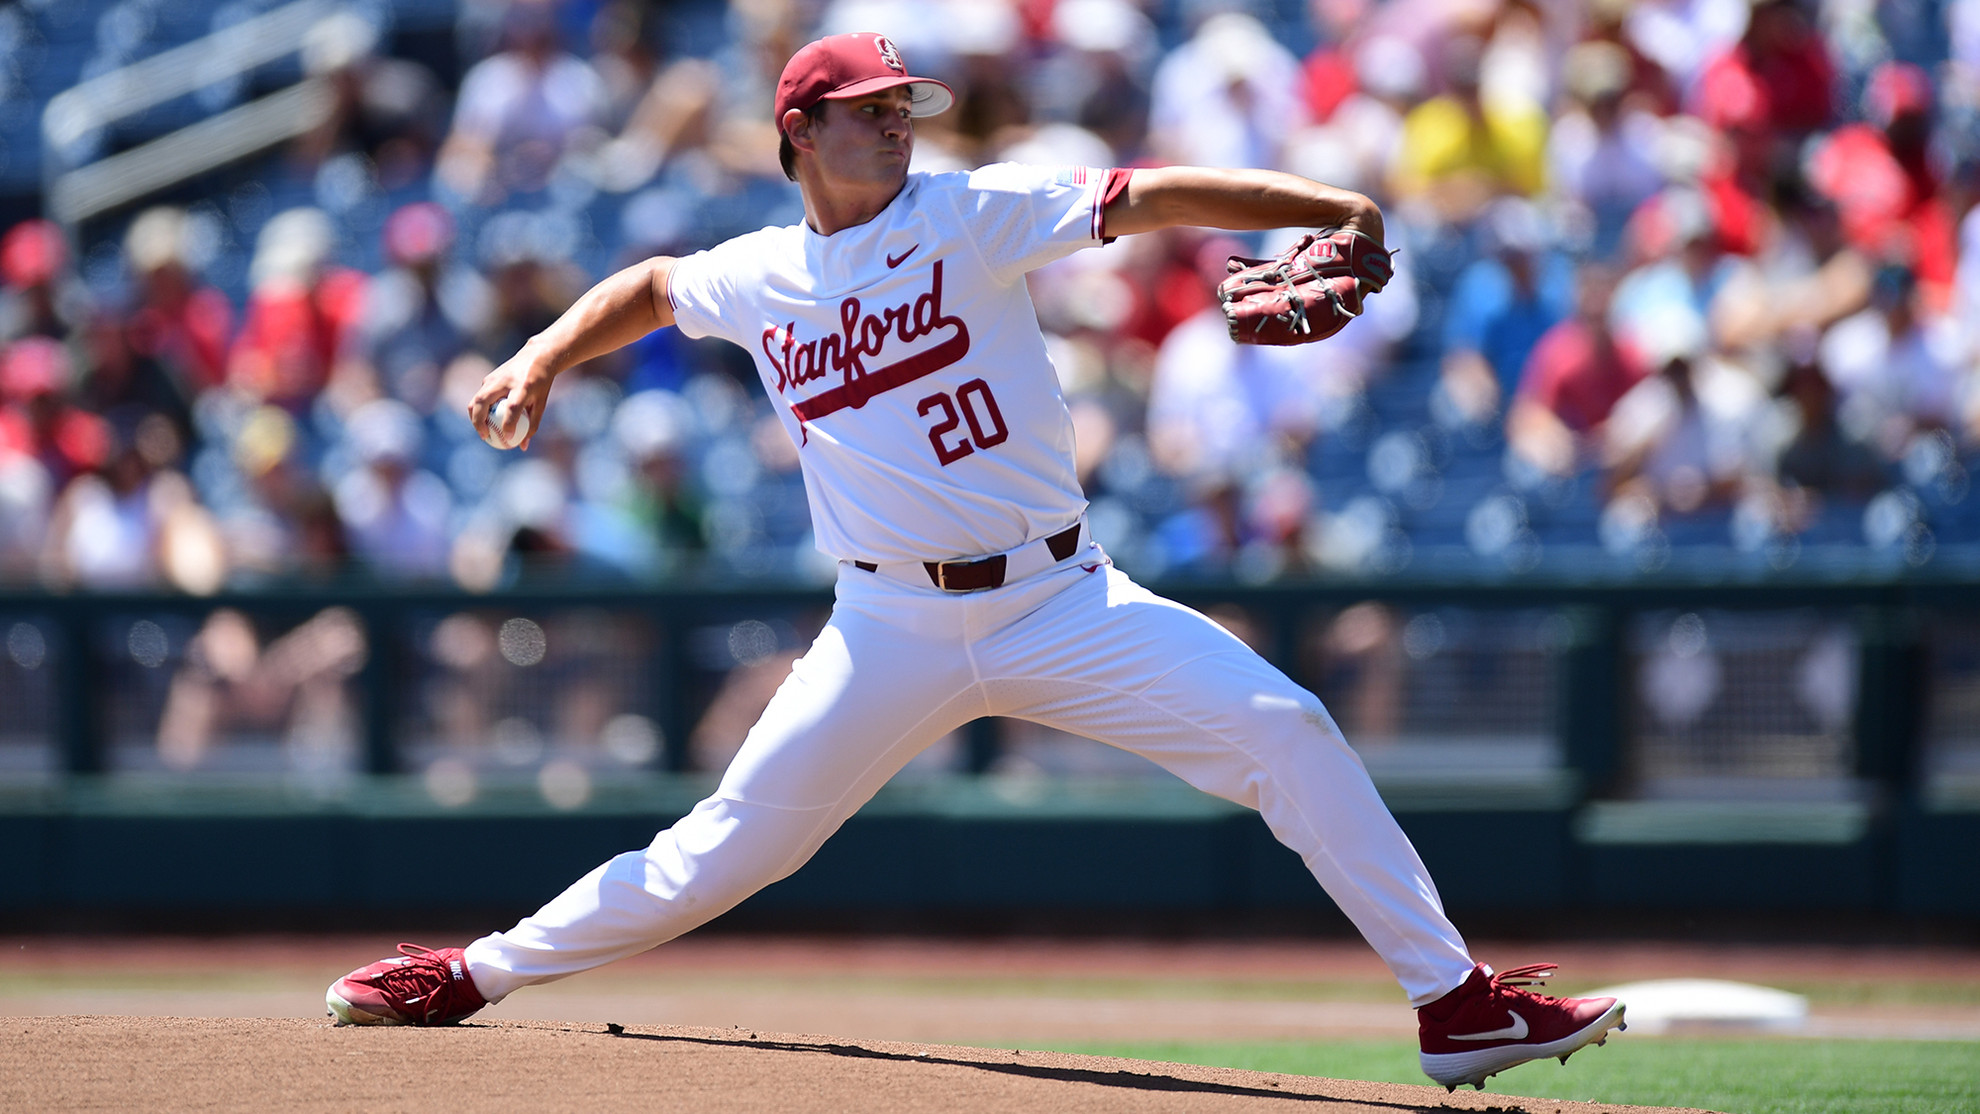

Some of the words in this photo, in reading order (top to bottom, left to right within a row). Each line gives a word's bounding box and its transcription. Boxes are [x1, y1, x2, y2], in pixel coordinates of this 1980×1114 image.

[762, 259, 944, 396] Stanford
[916, 378, 1009, 467] 20
[449, 960, 464, 980] NIKE
